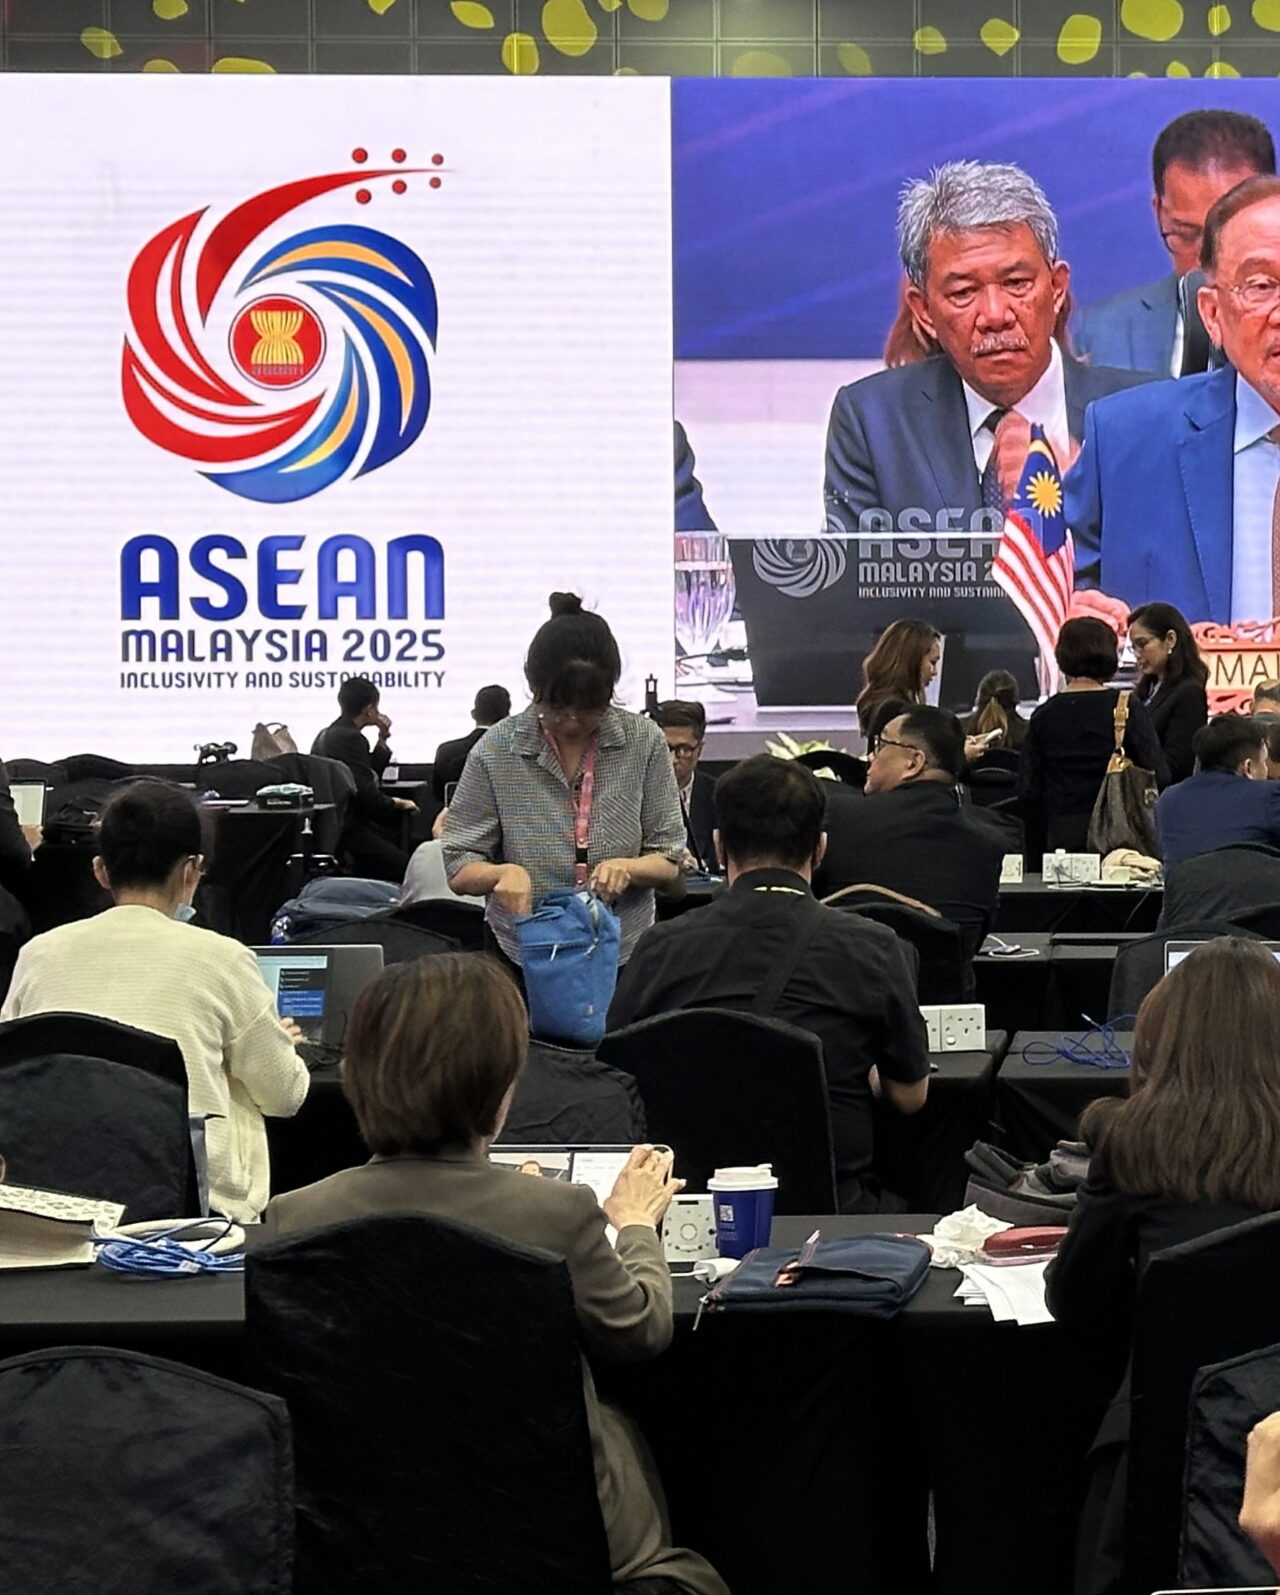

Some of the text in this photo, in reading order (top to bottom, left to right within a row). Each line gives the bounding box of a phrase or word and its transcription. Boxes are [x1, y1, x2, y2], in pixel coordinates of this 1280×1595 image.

[120, 533, 446, 622] ASEAN
[858, 561, 977, 583] MALAYSIA
[858, 586, 925, 598] INCLUSIVITY
[929, 586, 951, 598] AND
[120, 628, 446, 662] MALAYSIA 2025
[120, 671, 238, 689] INCLUSIVITY
[245, 671, 283, 689] AND
